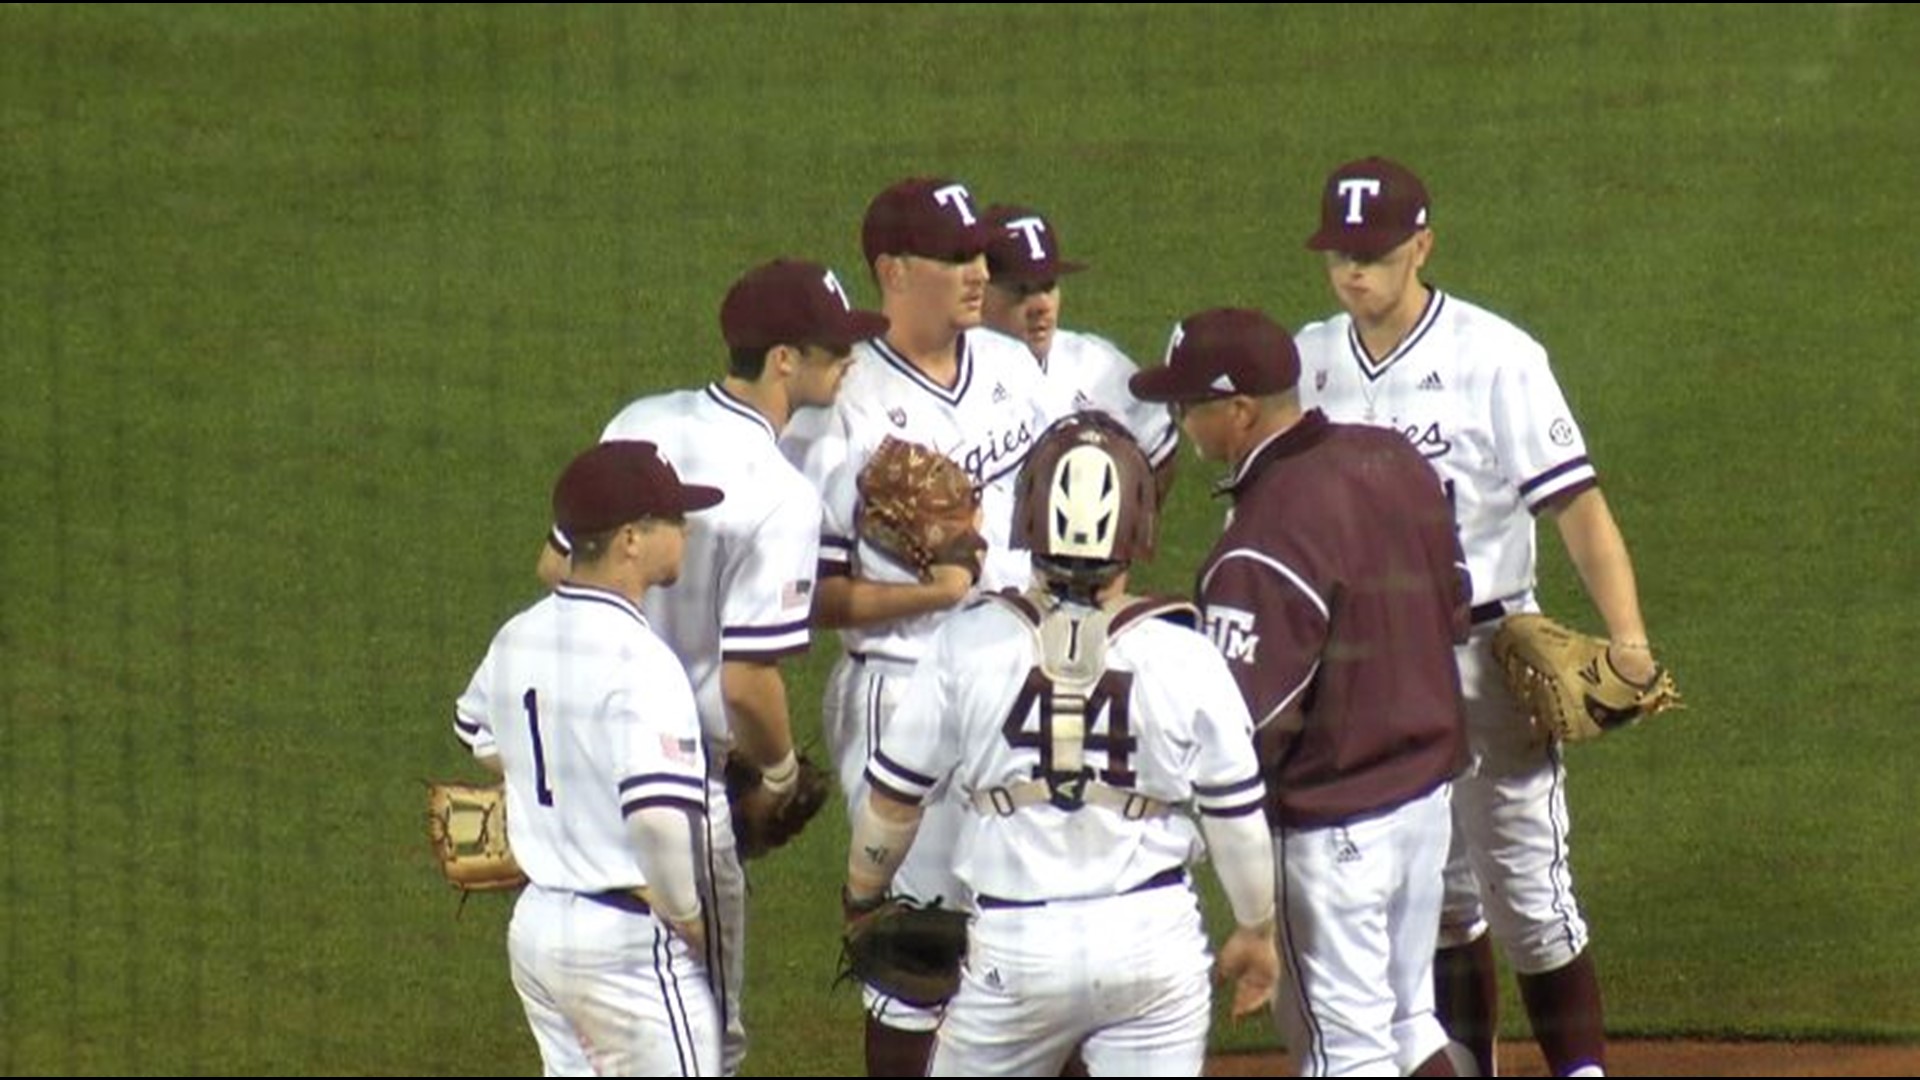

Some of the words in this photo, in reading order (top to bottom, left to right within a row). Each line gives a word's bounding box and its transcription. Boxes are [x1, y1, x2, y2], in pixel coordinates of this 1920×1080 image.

[933, 184, 976, 226] T
[1338, 179, 1380, 224] T
[1006, 216, 1046, 260] T
[964, 420, 1034, 486] gies
[523, 687, 554, 807] 1
[1002, 665, 1138, 789] 44
